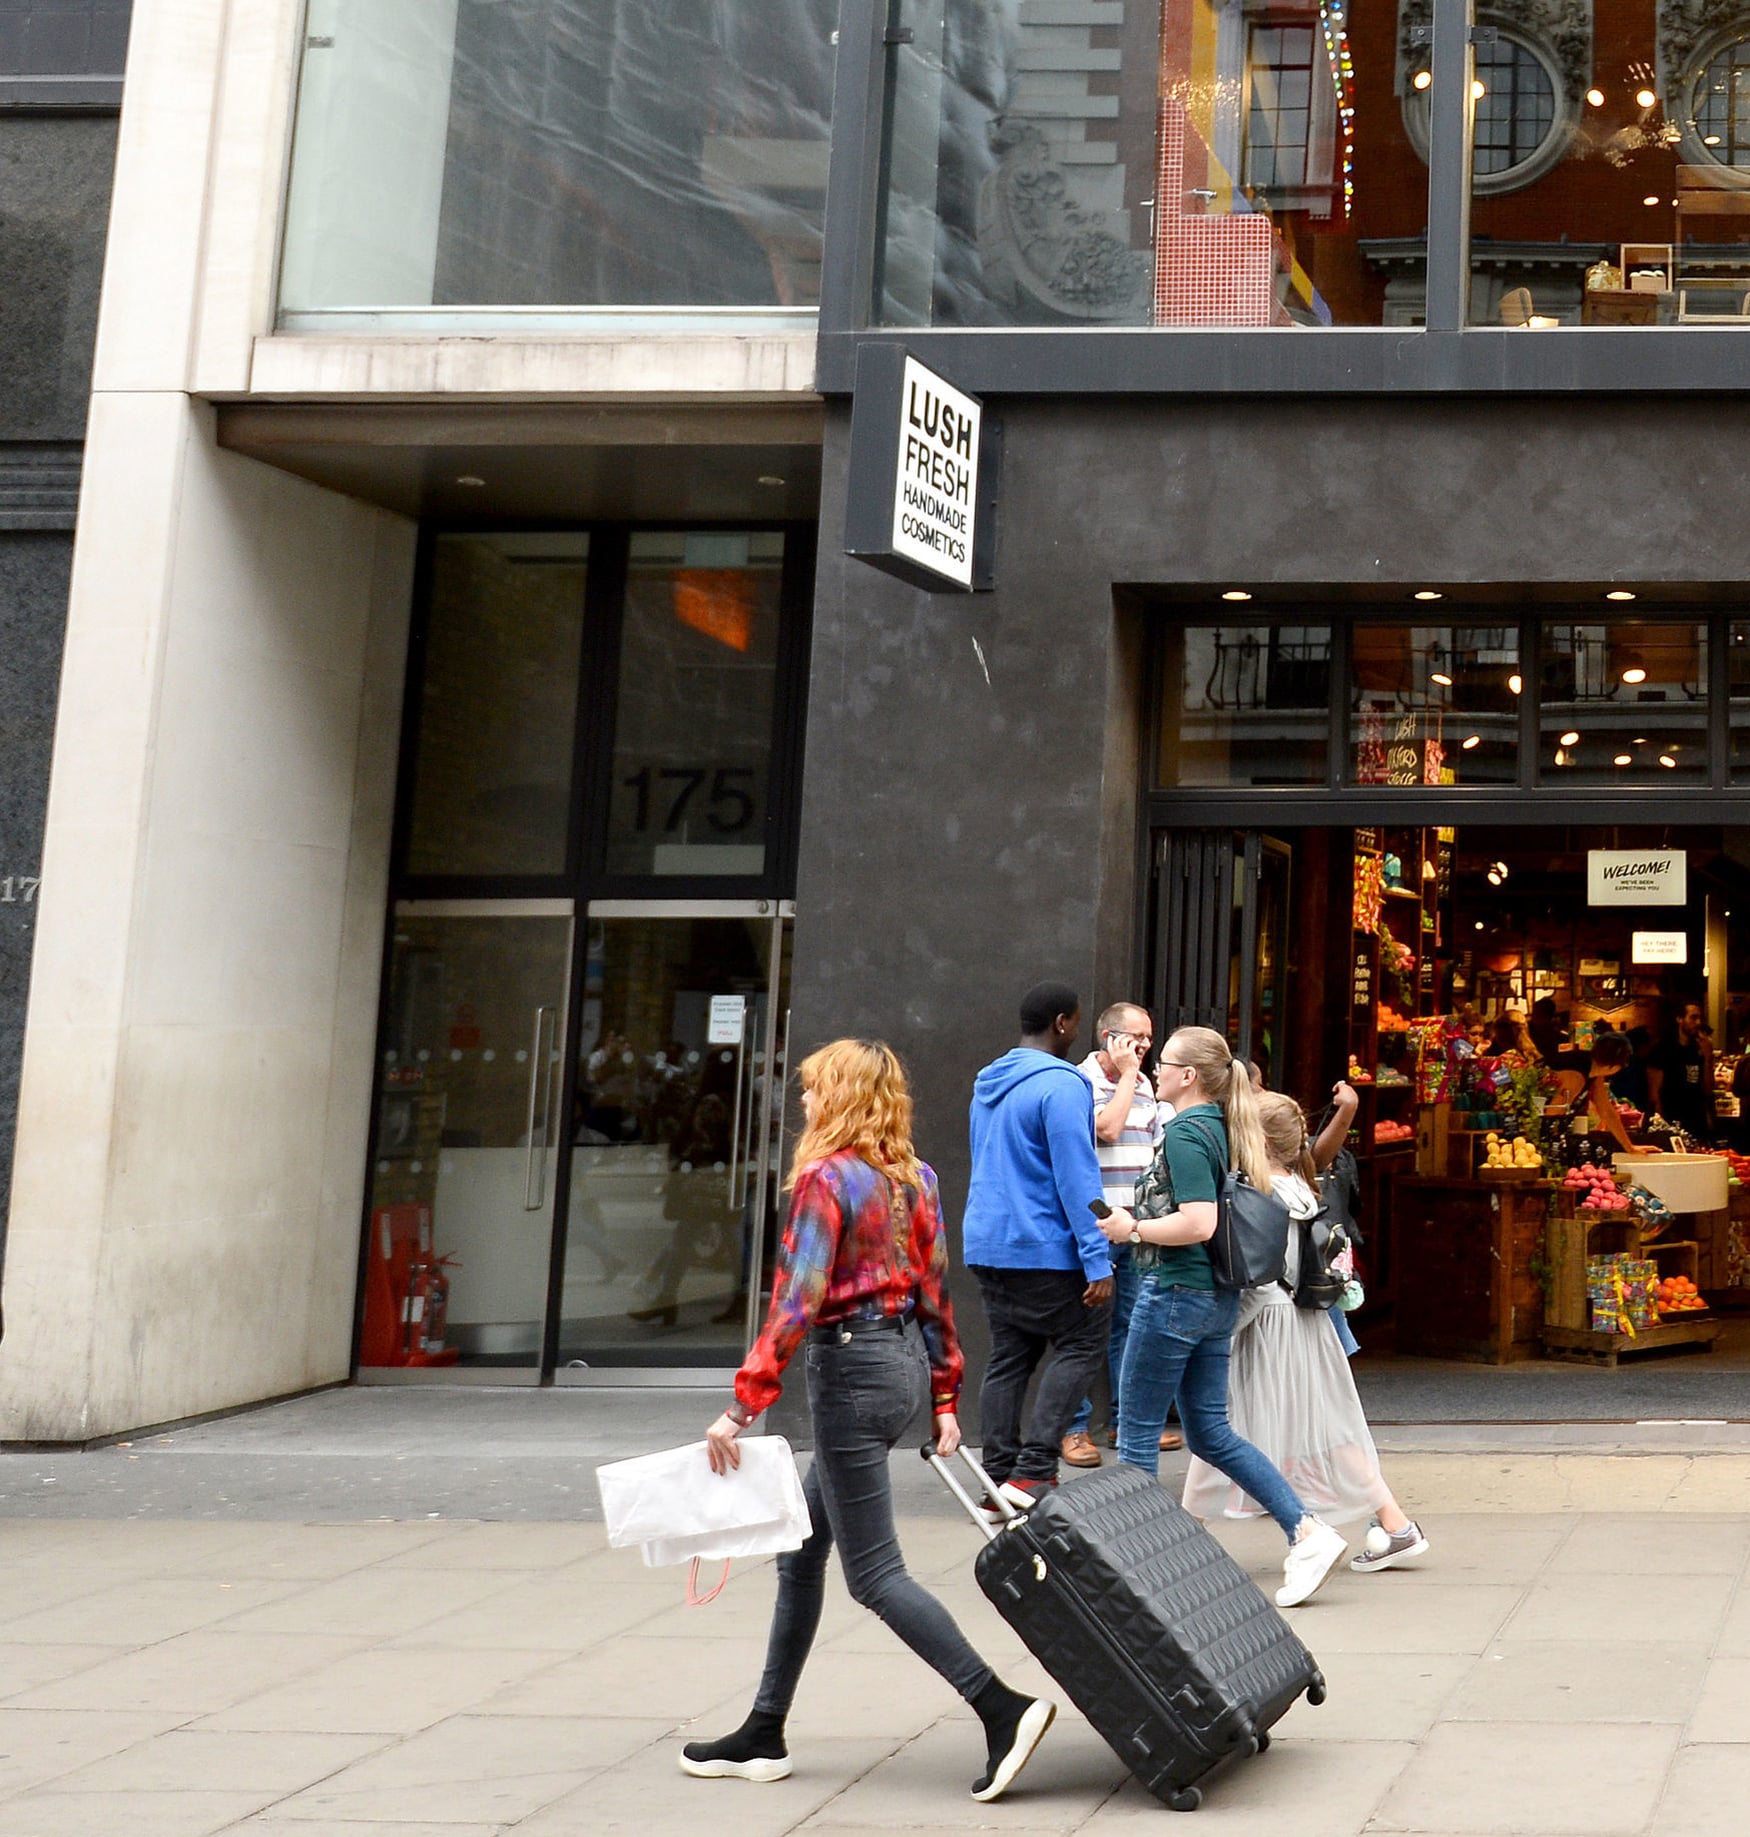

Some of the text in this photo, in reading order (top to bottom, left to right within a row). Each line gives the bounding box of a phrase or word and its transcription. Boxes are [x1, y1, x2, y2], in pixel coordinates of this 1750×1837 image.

[909, 380, 972, 461] LUSH
[905, 434, 969, 506] FRESH
[903, 480, 967, 535] HANDMADE
[901, 513, 966, 563] COSMETICS
[624, 768, 754, 832] 175
[1603, 860, 1671, 879] WELCOME!
